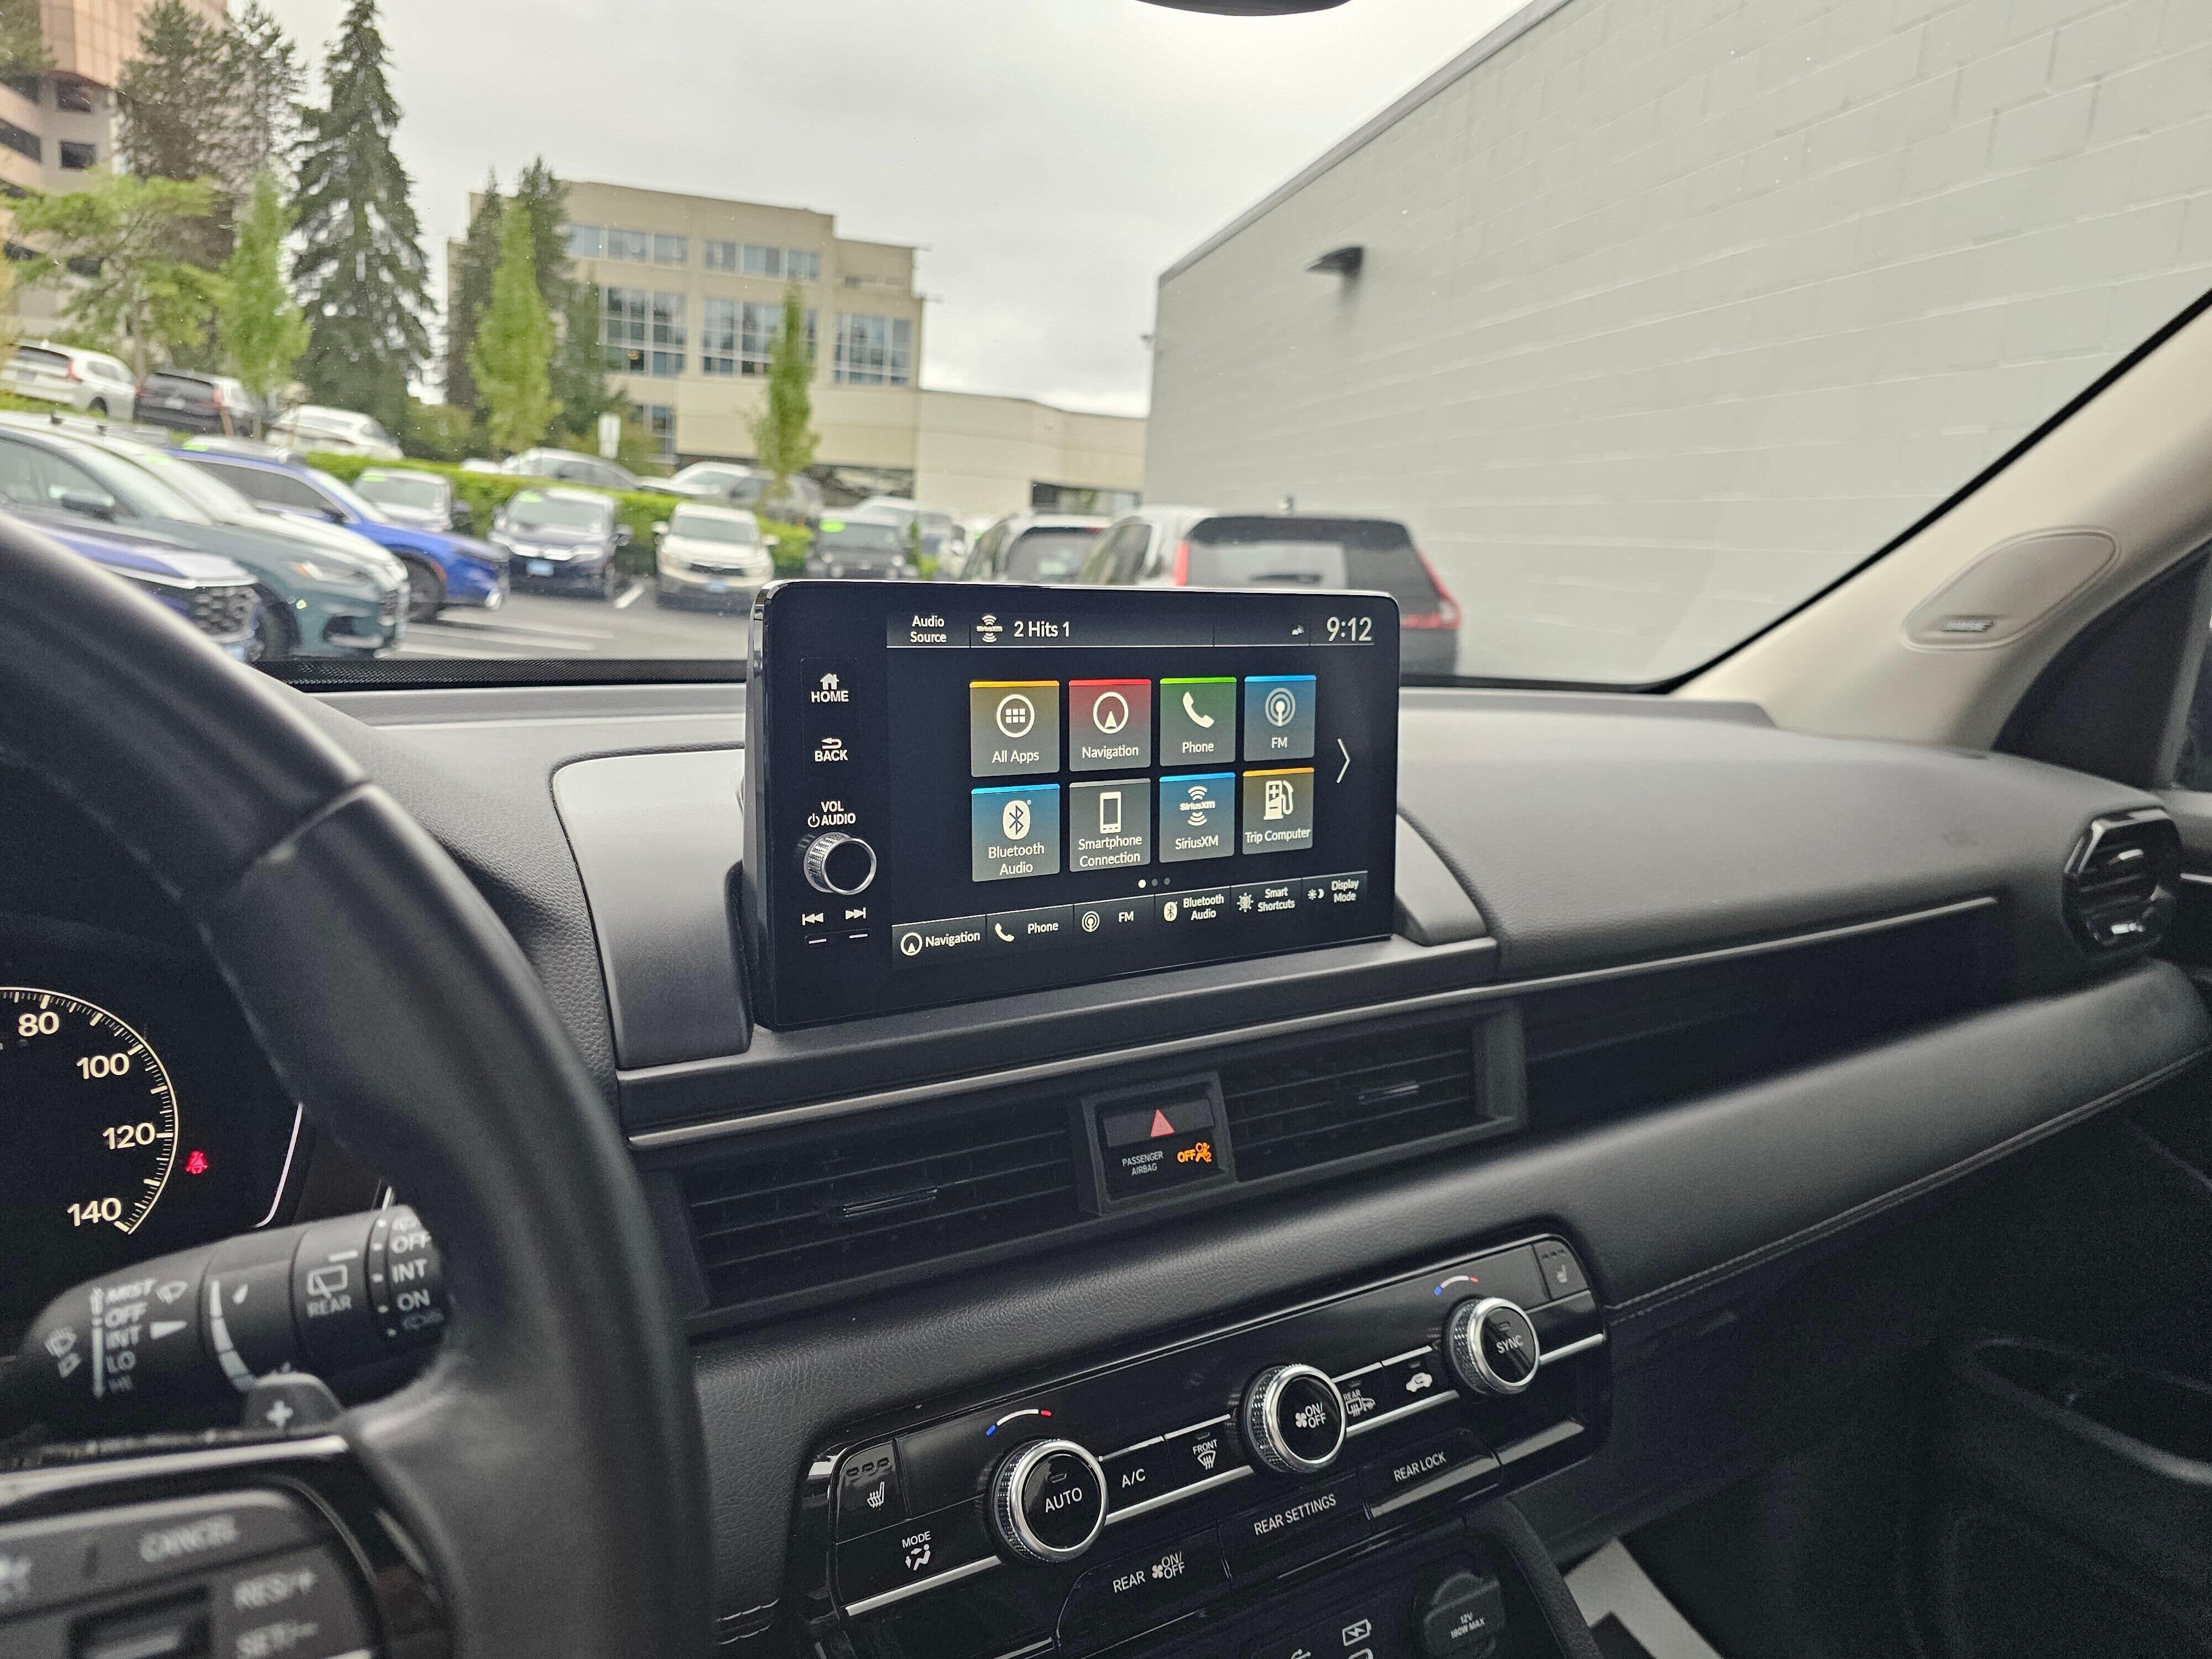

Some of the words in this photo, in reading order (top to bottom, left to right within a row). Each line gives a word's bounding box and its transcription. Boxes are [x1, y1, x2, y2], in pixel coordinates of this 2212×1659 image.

[911, 615, 945, 627] Audio
[1327, 617, 1373, 641] 9:12
[910, 632, 947, 643] Source
[1013, 621, 1024, 638] 2
[1027, 621, 1058, 638] Hits
[1062, 621, 1070, 637] 1
[811, 690, 849, 703] HOME
[1182, 741, 1214, 754] Phone
[1271, 737, 1288, 749] FM
[814, 749, 848, 762] BACK
[991, 750, 1008, 763] All
[1010, 749, 1040, 764] Apps
[1082, 744, 1139, 760] Navigation
[821, 800, 844, 813] VOL
[821, 813, 857, 826] AUDIO
[1078, 836, 1142, 851] Smartphone
[1175, 835, 1218, 850] SiriusXM
[1244, 831, 1262, 844] Trip
[1265, 828, 1311, 842] Computer
[988, 842, 1045, 859] Bluetooth
[1079, 851, 1140, 867] Connection
[999, 862, 1034, 876] Audio
[1265, 887, 1288, 899] Smart
[1331, 879, 1359, 892] Display
[1183, 894, 1224, 909] Bluetooth
[1333, 891, 1357, 902] Mode
[1257, 899, 1295, 913] Shortcuts
[1118, 911, 1134, 922] FM
[1191, 909, 1217, 921] Audio
[1027, 922, 1058, 935] Phone
[925, 931, 981, 948] Navigation
[18, 1011, 59, 1036] 80
[76, 1052, 130, 1079] 100
[102, 1122, 156, 1150] 120
[1121, 1151, 1164, 1167] PASSENGER
[1177, 1149, 1196, 1163] OFF
[1131, 1163, 1157, 1176] AIRBAG
[66, 1197, 122, 1227] 140
[390, 1230, 431, 1254] OFF
[391, 1258, 428, 1284] INT
[306, 1293, 352, 1318] REAR
[397, 1288, 430, 1312] ON
[105, 1301, 148, 1328] OFF
[105, 1324, 142, 1350] INT
[1496, 1334, 1524, 1354] SYNC
[106, 1350, 136, 1374] LO
[1343, 1389, 1362, 1401] REAR
[1305, 1401, 1323, 1417] ON/
[1308, 1412, 1327, 1428] OFF
[1192, 1439, 1218, 1455] FRONT
[1393, 1464, 1420, 1482] REAR
[1420, 1451, 1448, 1472] LOCK
[1121, 1468, 1146, 1488] A/C
[1044, 1486, 1083, 1514] AUTO
[1253, 1513, 1284, 1536] REAR
[1285, 1493, 1337, 1524] SETTINGS
[901, 1531, 931, 1548] MODE
[1161, 1550, 1182, 1568] ON/
[1164, 1561, 1185, 1579] OFF
[1113, 1571, 1146, 1593] REAR
[1460, 1611, 1473, 1625] 12V
[1469, 1616, 1485, 1631] MAX
